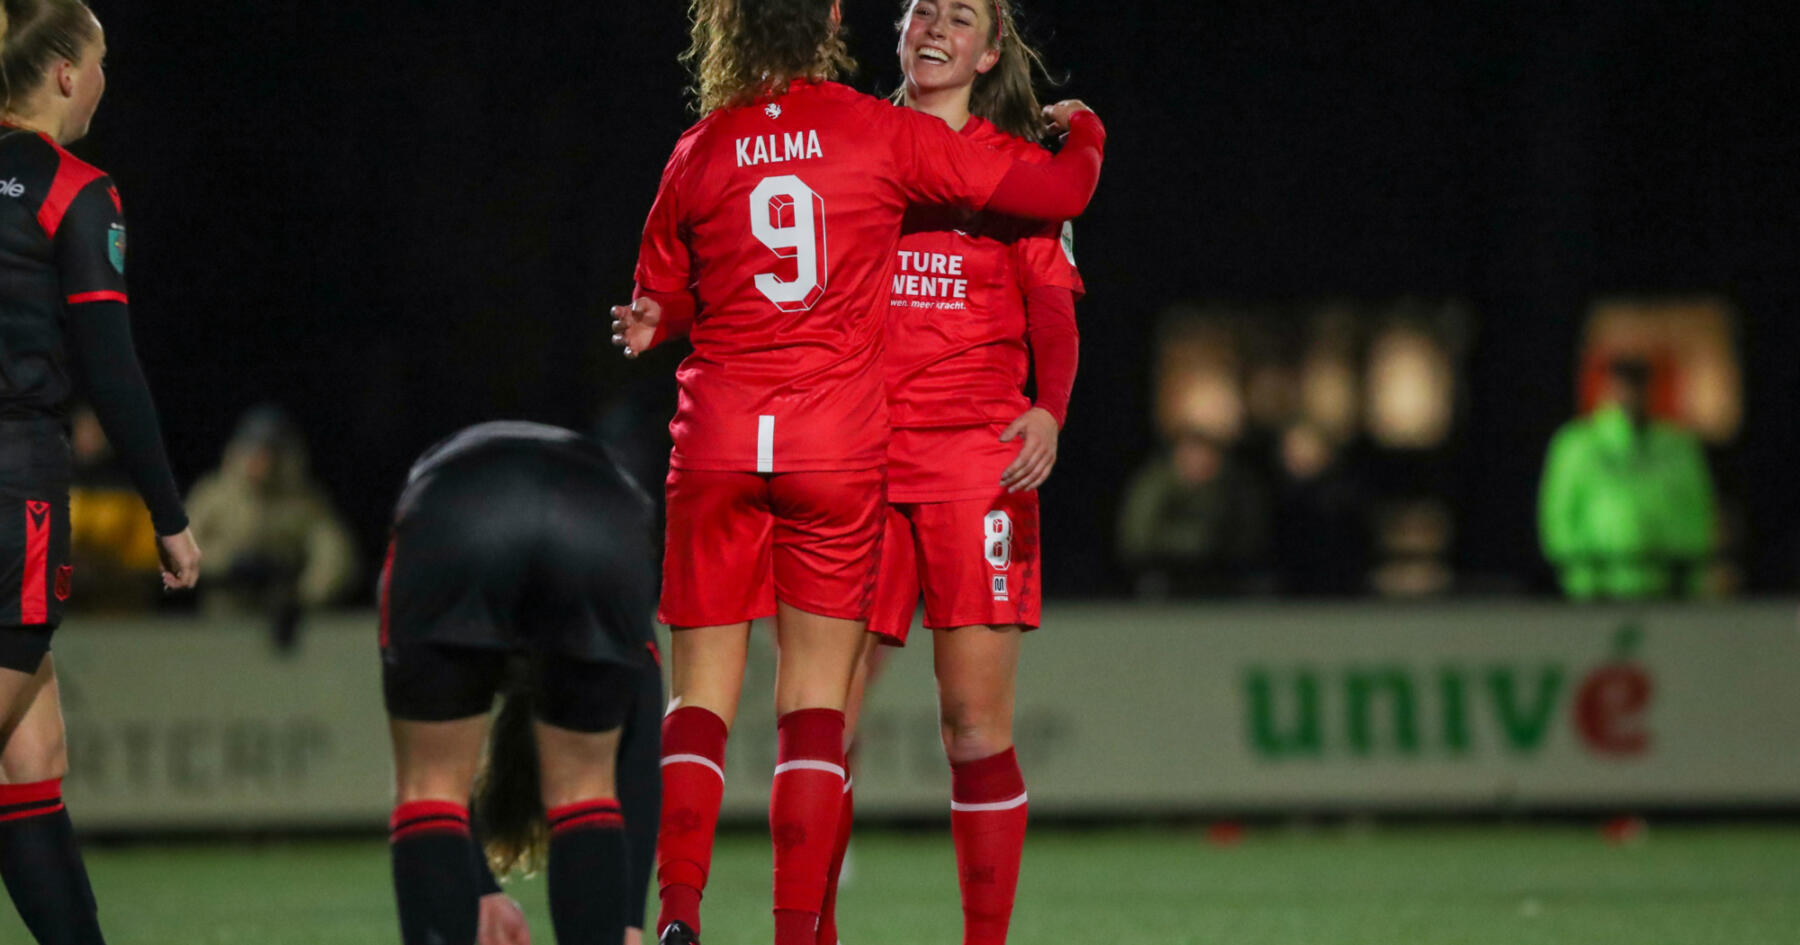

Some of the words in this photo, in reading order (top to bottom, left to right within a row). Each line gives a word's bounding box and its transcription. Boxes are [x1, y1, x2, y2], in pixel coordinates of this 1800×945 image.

[735, 129, 823, 167] KALMA
[749, 174, 828, 313] 9
[897, 251, 963, 275] TURE
[984, 509, 1013, 571] 8
[1243, 622, 1653, 758] univé
